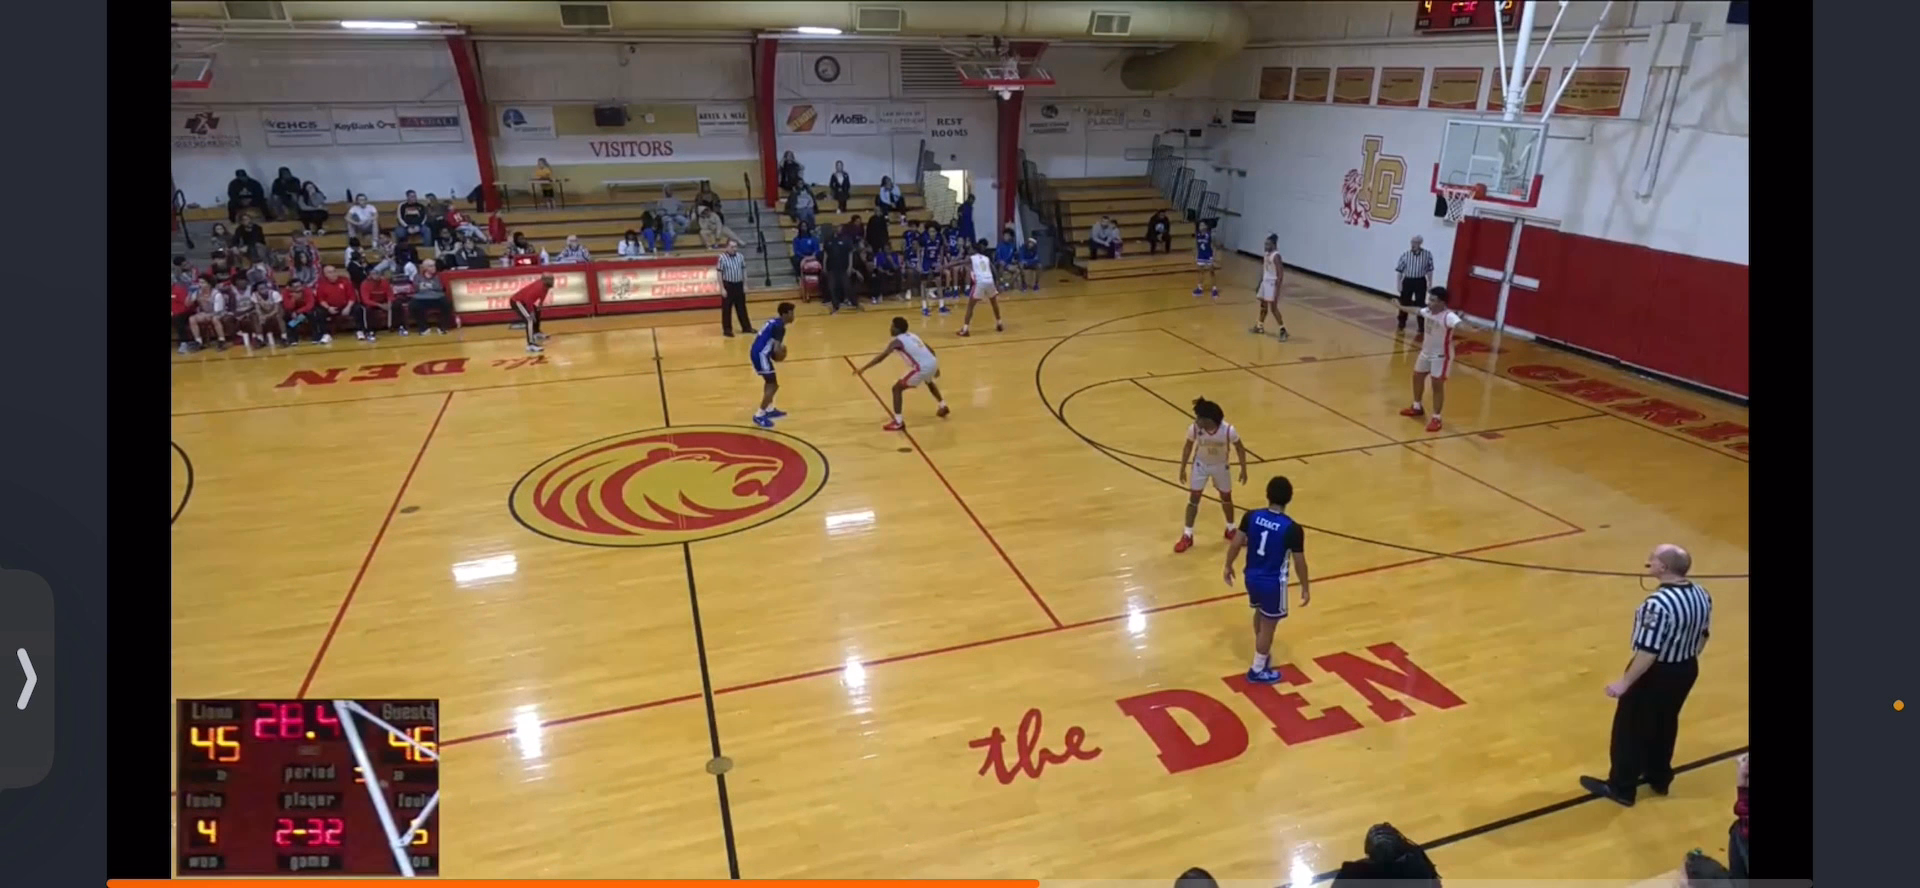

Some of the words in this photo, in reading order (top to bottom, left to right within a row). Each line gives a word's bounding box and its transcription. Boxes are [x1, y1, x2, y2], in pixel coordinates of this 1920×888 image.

[937, 118, 963, 126] REST
[931, 129, 969, 137] ROOMS
[590, 140, 674, 158] VISITORS
[274, 357, 471, 389] DEN
[1255, 515, 1281, 533] LEGACY
[1256, 529, 1270, 557] 1
[968, 707, 1102, 785] the
[1115, 641, 1468, 775] DEN
